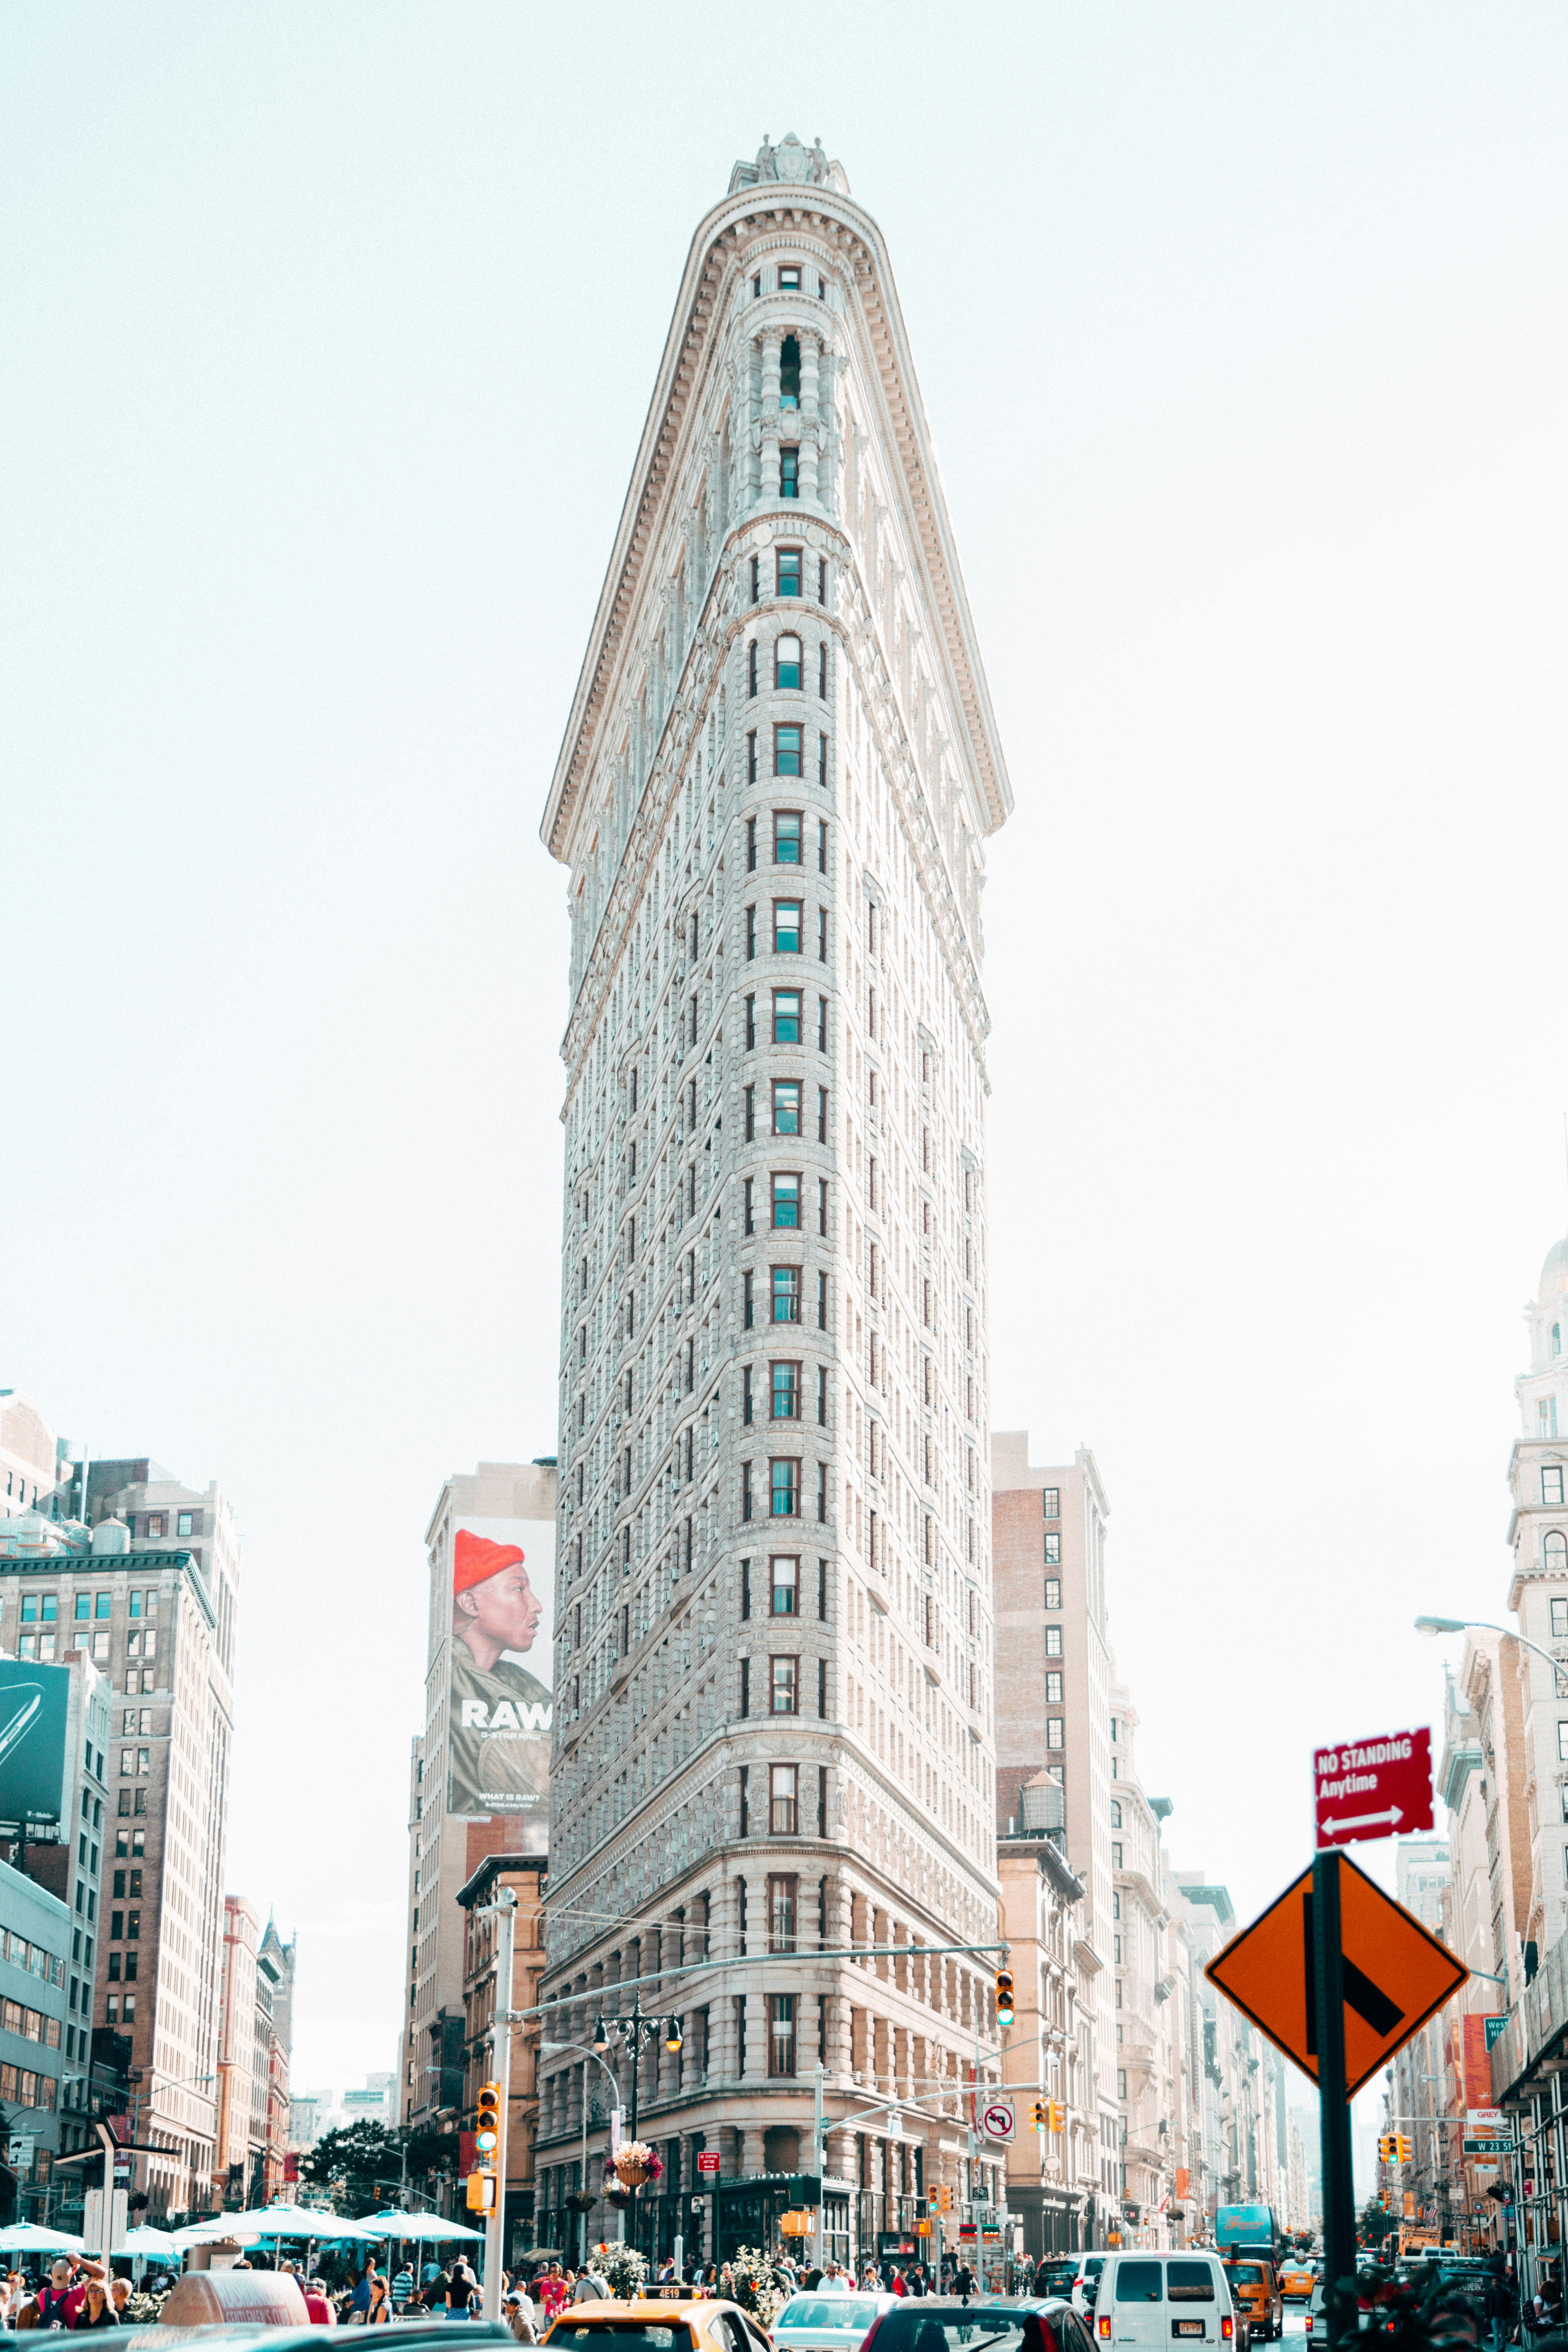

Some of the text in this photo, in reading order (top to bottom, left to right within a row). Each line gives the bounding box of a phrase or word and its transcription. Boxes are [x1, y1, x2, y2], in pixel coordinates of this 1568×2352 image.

[462, 1699, 553, 1730] RAW
[481, 1732, 517, 1740] G-STAR
[1318, 1738, 1412, 1774] NO STANDING
[1320, 1773, 1377, 1800] Anytime
[479, 1792, 505, 1800] WHAT
[1478, 2143, 1511, 2151] W 23 St
[659, 2288, 680, 2298] 4E19
[226, 2309, 272, 2324] GENTLEMEN'S
[272, 2308, 292, 2325] CLUB
